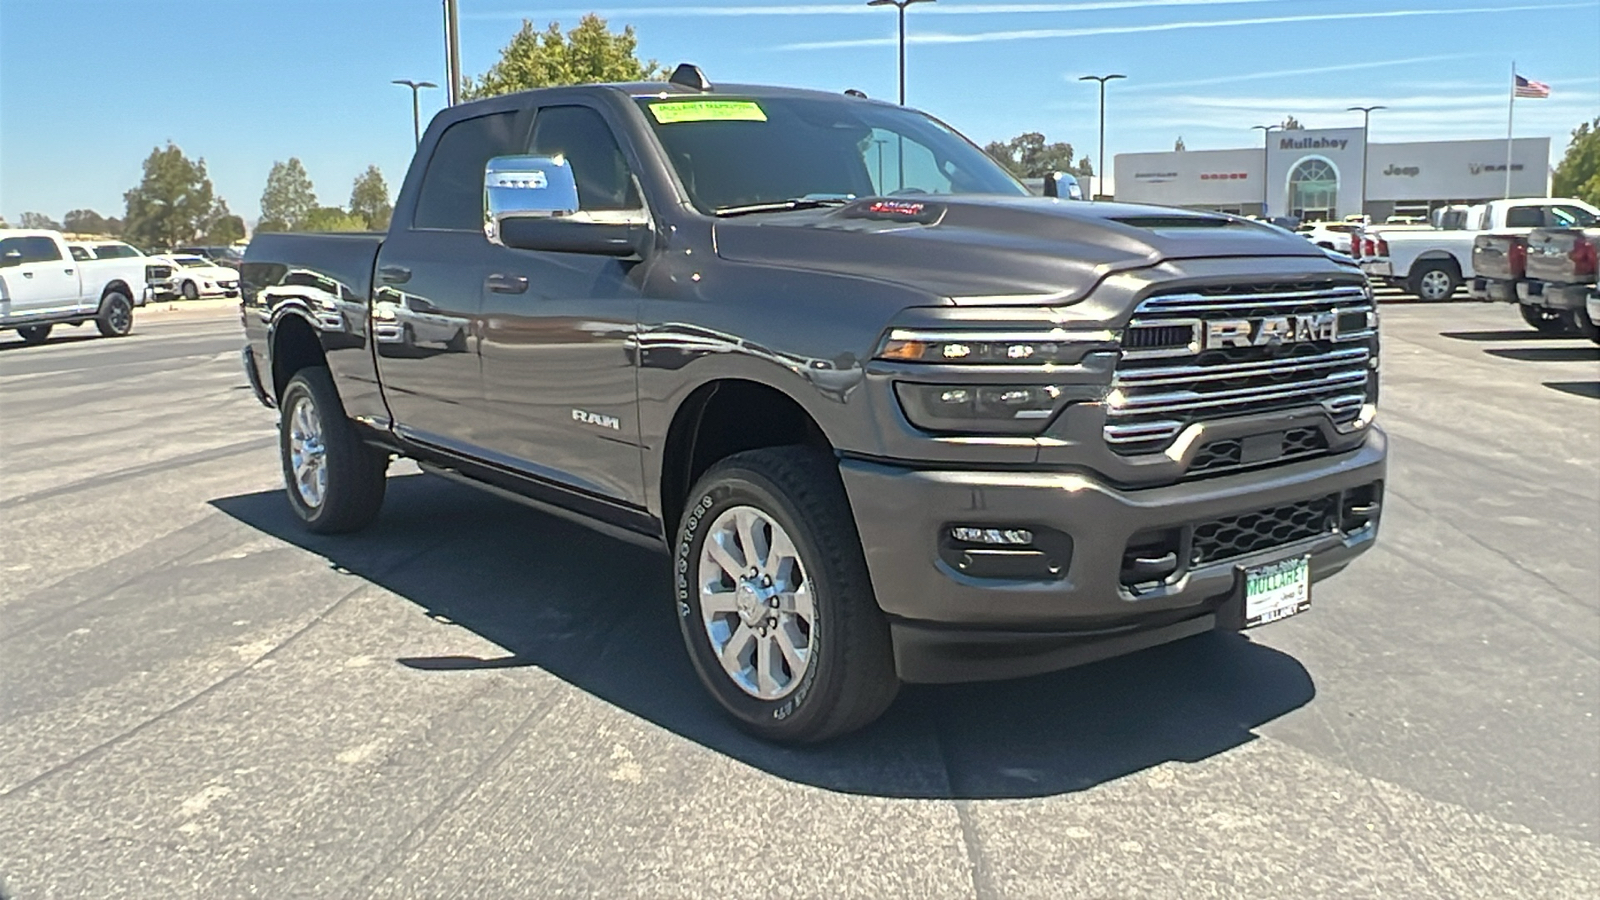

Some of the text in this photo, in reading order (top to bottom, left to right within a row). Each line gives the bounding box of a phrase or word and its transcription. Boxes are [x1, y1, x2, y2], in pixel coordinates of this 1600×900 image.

[1279, 137, 1348, 150] Mullahey
[1383, 164, 1420, 177] Jeep
[1206, 313, 1334, 349] RAM
[572, 409, 620, 430] RAM
[1246, 566, 1306, 596] MULLAHEY
